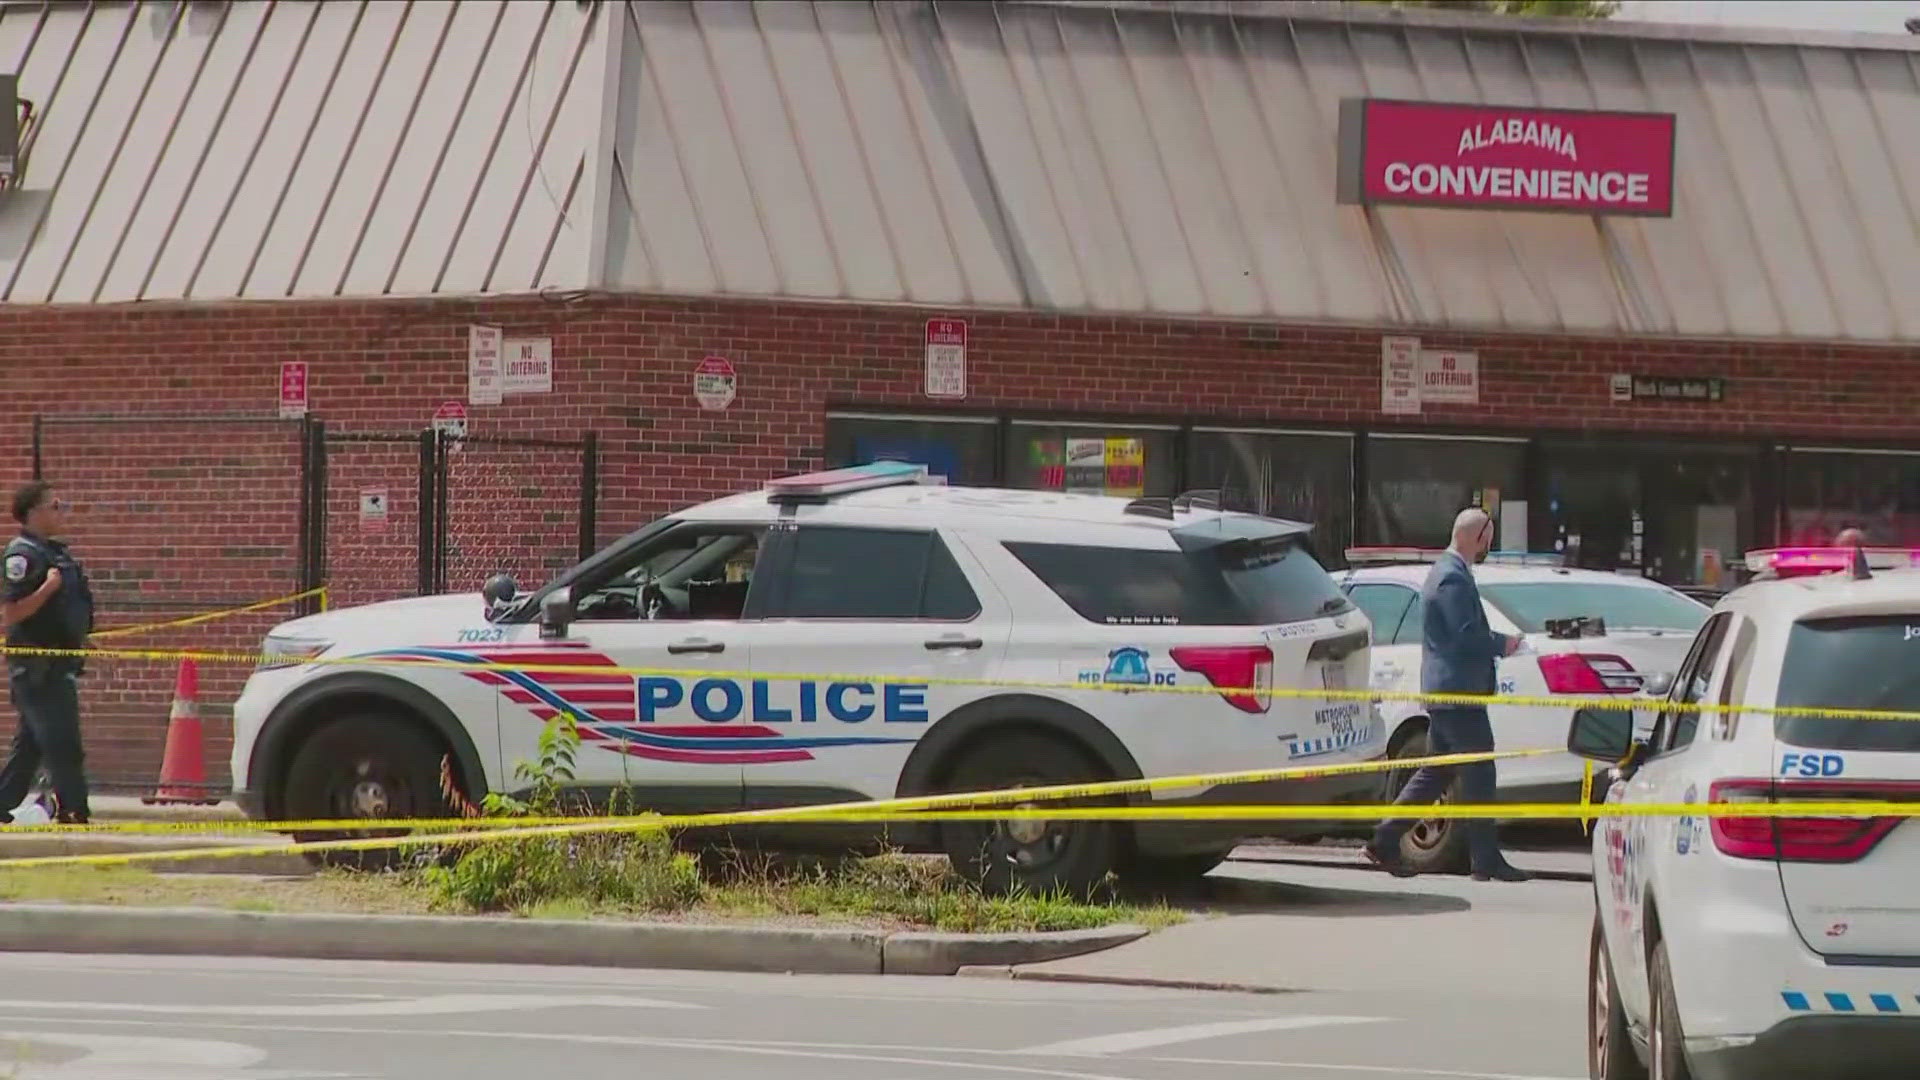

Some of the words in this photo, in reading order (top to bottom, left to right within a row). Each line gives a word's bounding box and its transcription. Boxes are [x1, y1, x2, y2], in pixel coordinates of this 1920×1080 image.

[1457, 118, 1577, 162] ALABAMA
[1384, 162, 1649, 203] CONVENIENCE
[940, 322, 953, 333] NO
[521, 345, 532, 359] NO
[506, 361, 547, 376] LOITERING
[1442, 357, 1456, 371] NO
[1425, 372, 1473, 386] LOITERING
[1106, 616, 1118, 624] We
[1134, 615, 1151, 624] here
[1153, 615, 1161, 624] to
[1162, 615, 1179, 626] help
[457, 628, 503, 643] 7023
[1154, 672, 1176, 686] DC
[1501, 681, 1515, 693] DC
[637, 677, 929, 723] POLICE
[1780, 753, 1844, 776] FSD
